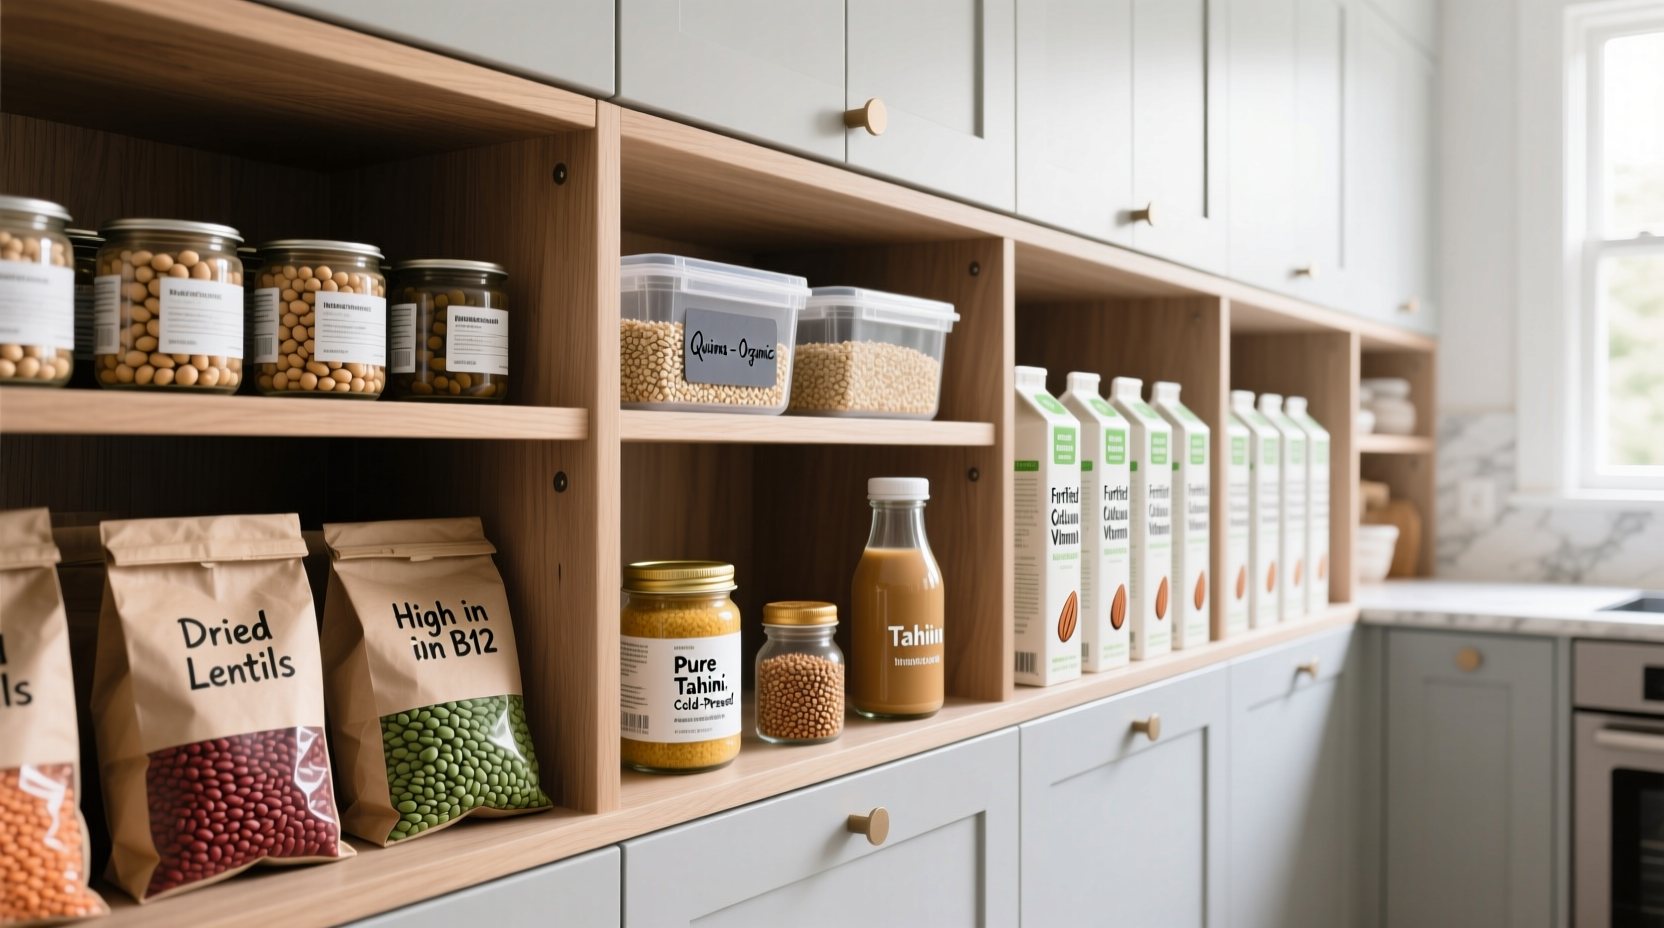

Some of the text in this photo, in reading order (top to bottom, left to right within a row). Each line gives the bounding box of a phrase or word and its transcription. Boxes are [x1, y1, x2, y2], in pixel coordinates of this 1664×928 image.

[178, 609, 273, 649] Dried
[392, 599, 489, 637] High in
[449, 628, 498, 657] B12
[186, 645, 296, 691] Lentils
[674, 655, 717, 674] Pure
